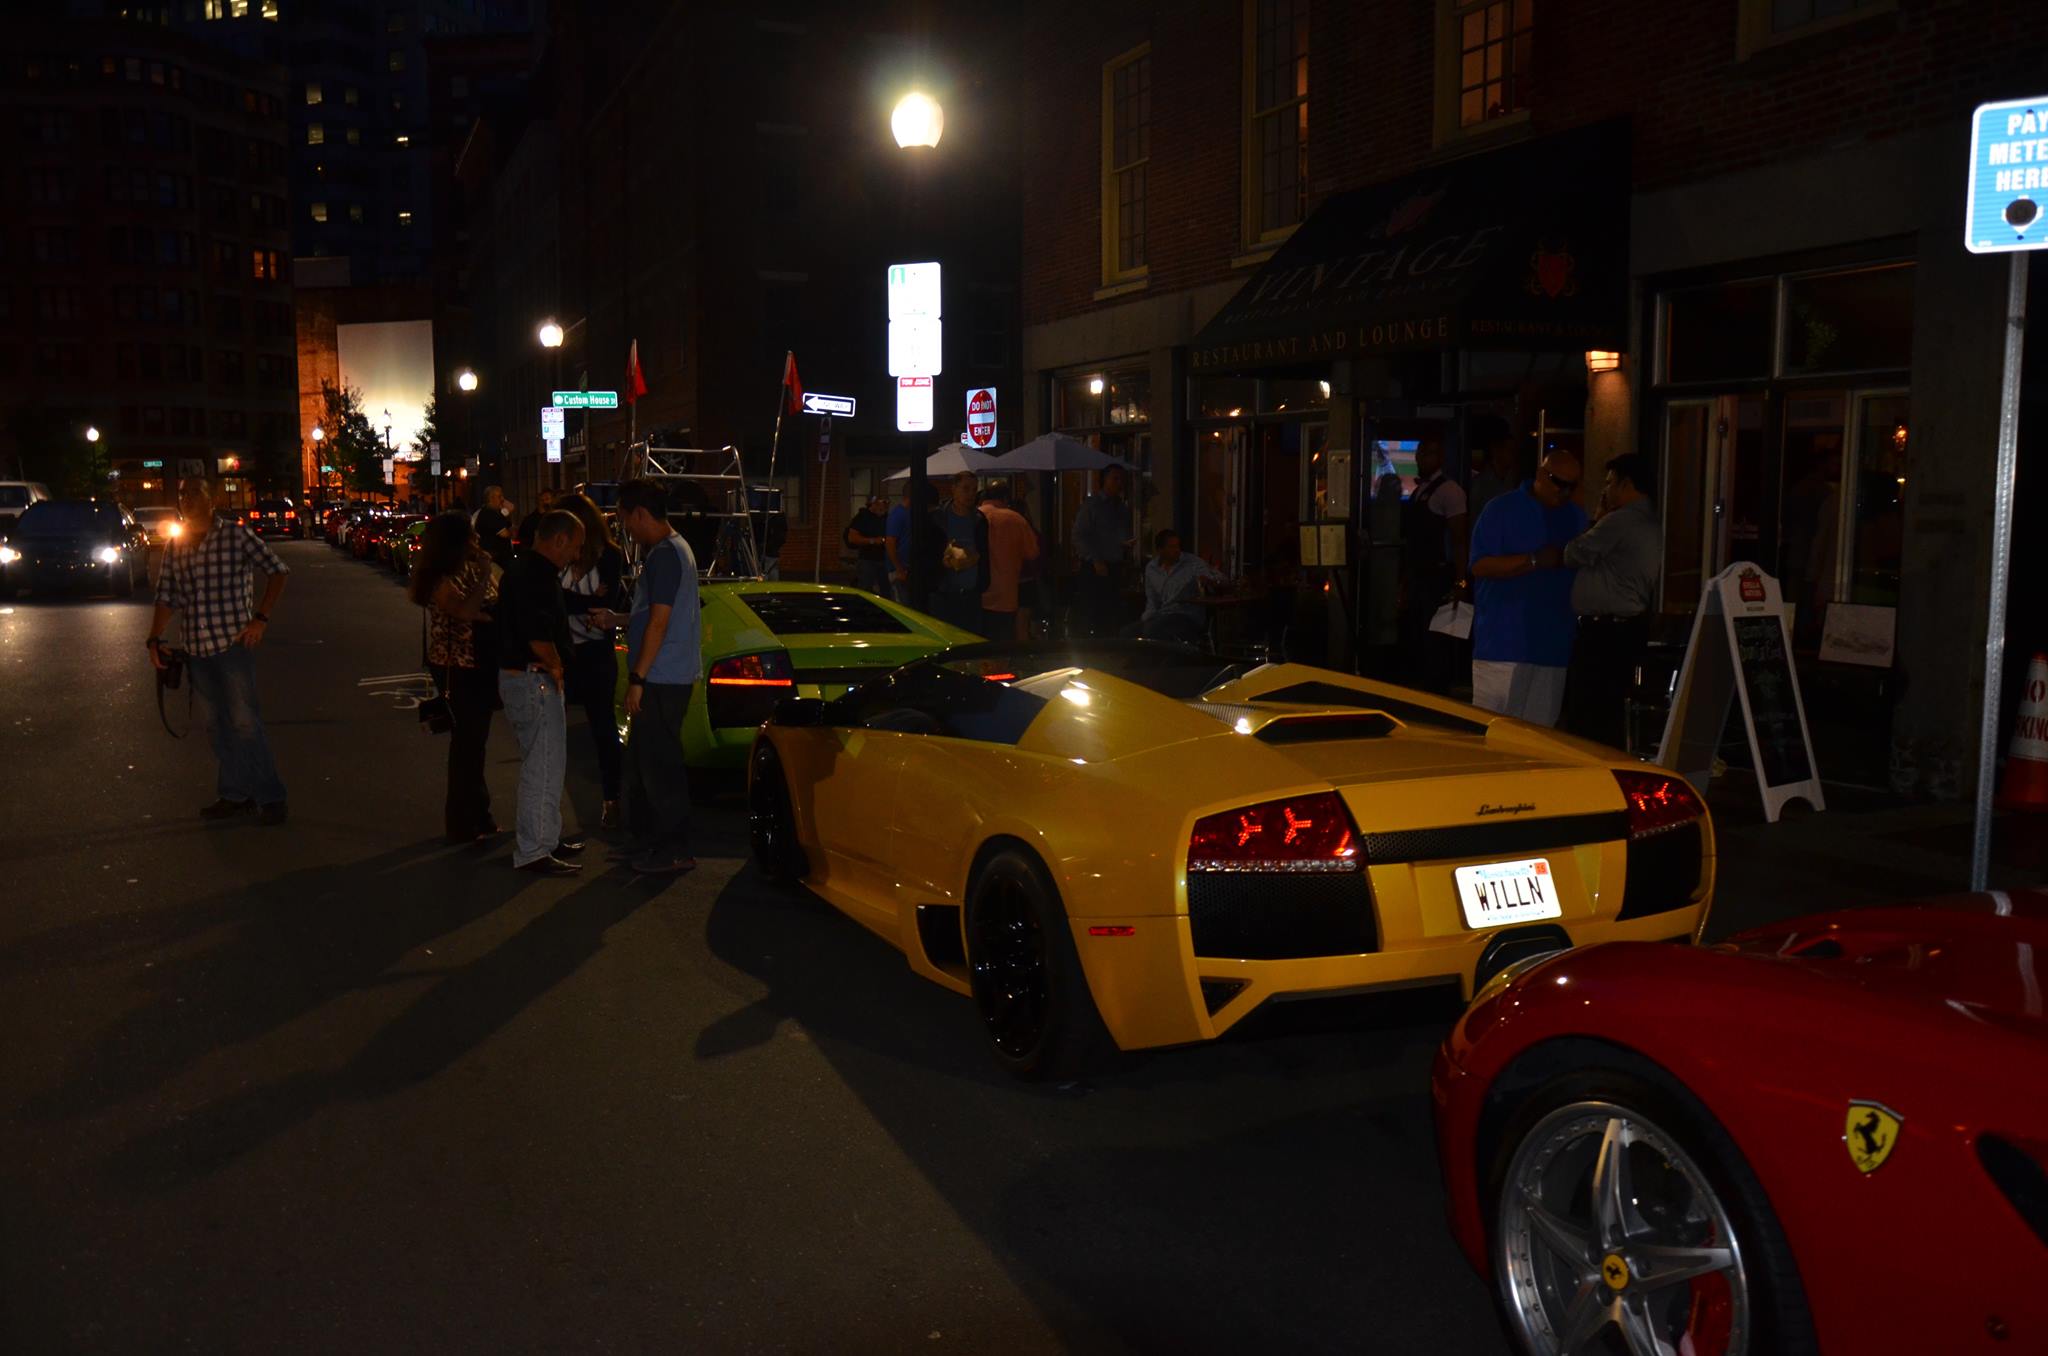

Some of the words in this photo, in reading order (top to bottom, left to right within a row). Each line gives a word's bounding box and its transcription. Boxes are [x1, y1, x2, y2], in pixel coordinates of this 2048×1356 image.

[2007, 111, 2048, 137] PAY
[1249, 225, 1504, 305] VINTAGE
[1191, 336, 1298, 368] RESTAURANT
[1309, 331, 1348, 353] AND
[1359, 314, 1449, 348] LOUNGE
[563, 395, 588, 405] Custom
[589, 395, 610, 405] House
[971, 401, 980, 411] DO
[981, 399, 992, 411] NOT
[1475, 803, 1537, 816] Lamborghini
[1474, 875, 1544, 912] WILLN
